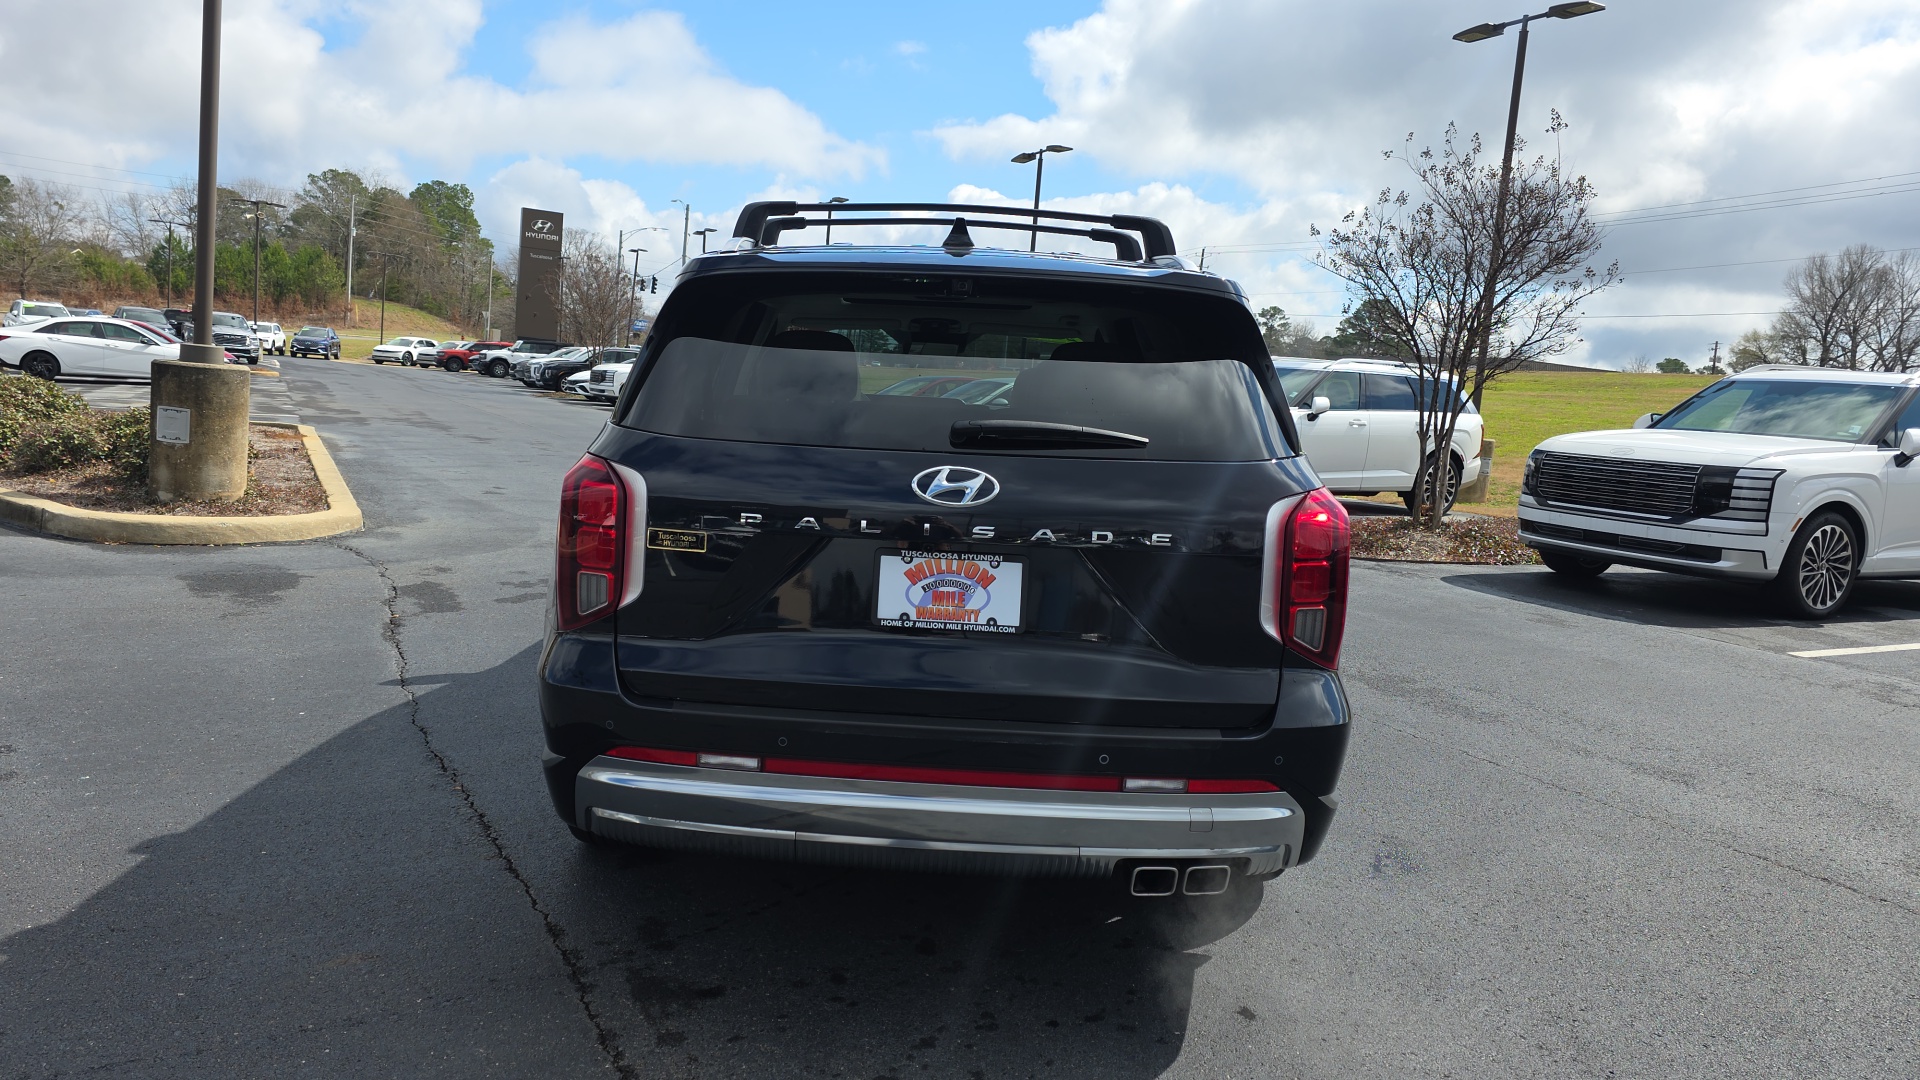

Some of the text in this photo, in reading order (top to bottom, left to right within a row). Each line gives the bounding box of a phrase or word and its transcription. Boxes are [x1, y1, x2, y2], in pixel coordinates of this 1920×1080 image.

[525, 231, 559, 241] HYUNDAI
[657, 531, 697, 542] Tuscaloosa
[739, 512, 1173, 547] PALISADE
[900, 549, 1003, 562] TUSCALOOSA HYUNDAI
[903, 558, 997, 590] MILLION
[931, 589, 966, 608] MILE
[915, 606, 981, 623] WARRANTY
[880, 619, 1016, 634] HOME OF MILLION MILE HYUNDAI.COM
